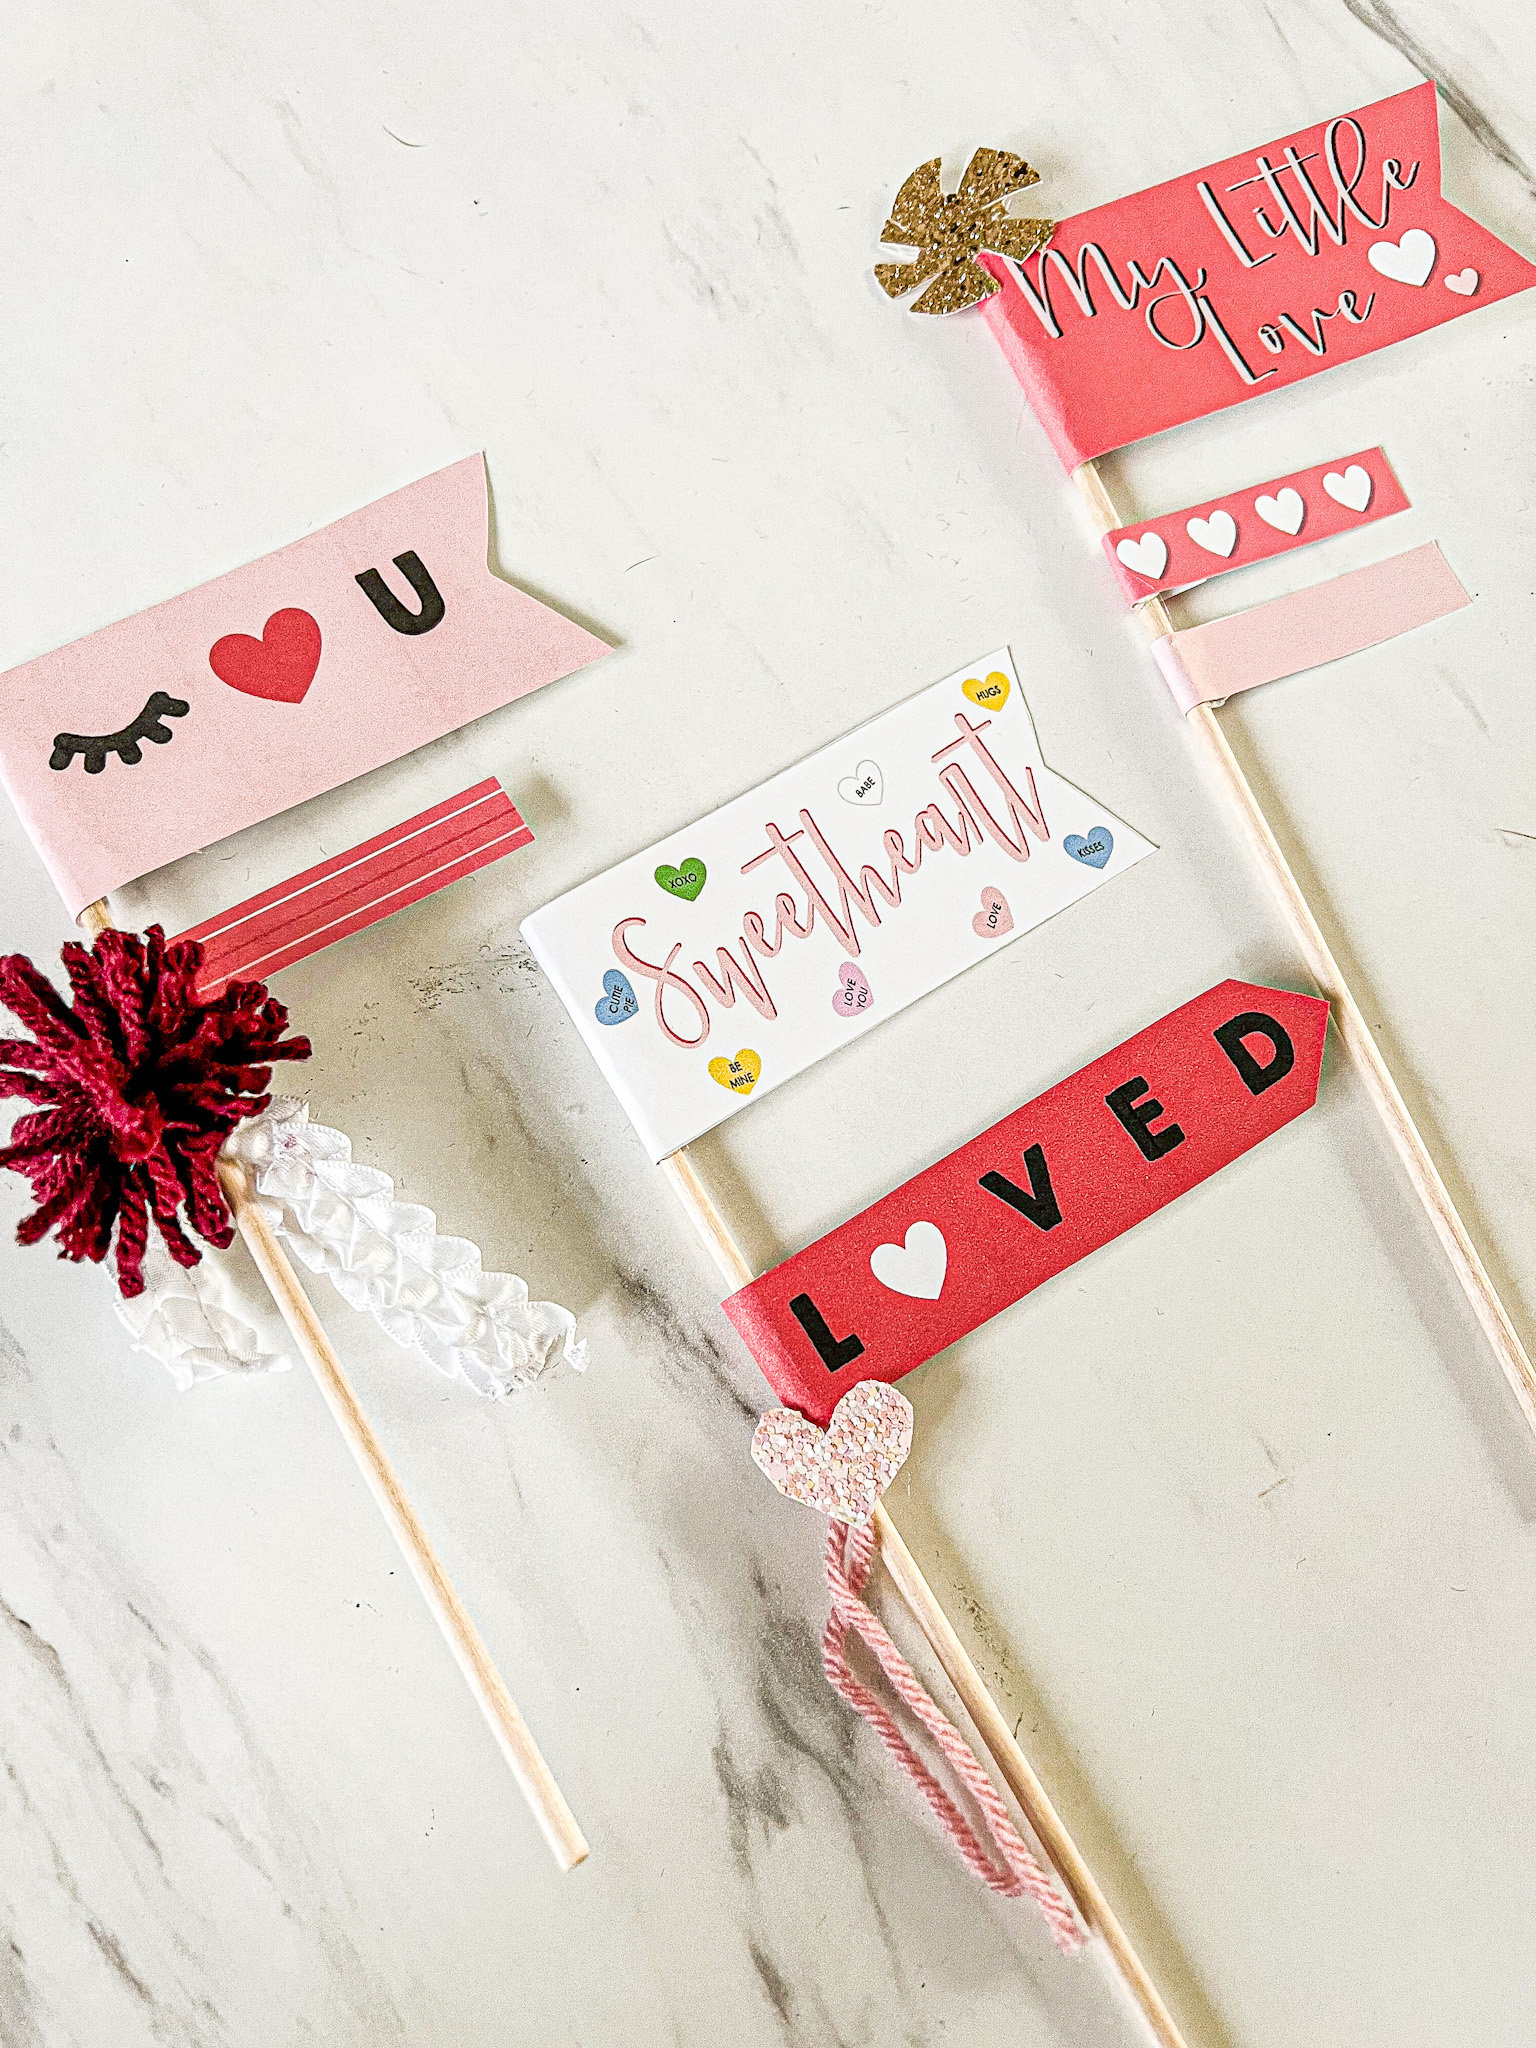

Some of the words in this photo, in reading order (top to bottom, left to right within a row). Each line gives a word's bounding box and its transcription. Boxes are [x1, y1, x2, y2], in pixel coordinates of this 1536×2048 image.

[1009, 242, 1207, 349] My
[1197, 116, 1421, 268] Little
[1199, 289, 1376, 385] Love
[354, 549, 446, 636] U
[976, 685, 1002, 701] HUGS
[855, 776, 876, 798] BABE
[1077, 841, 1106, 858] KISSES
[611, 712, 1051, 1049] Sweetheart
[667, 873, 697, 888] XOXO
[986, 902, 1002, 930] LOVE
[609, 984, 624, 1014] CUTIE
[843, 978, 857, 1007] LOVE
[856, 986, 869, 1008] YOU
[623, 996, 635, 1013] PIE
[729, 1061, 743, 1073] BE
[729, 1072, 756, 1091] MINE
